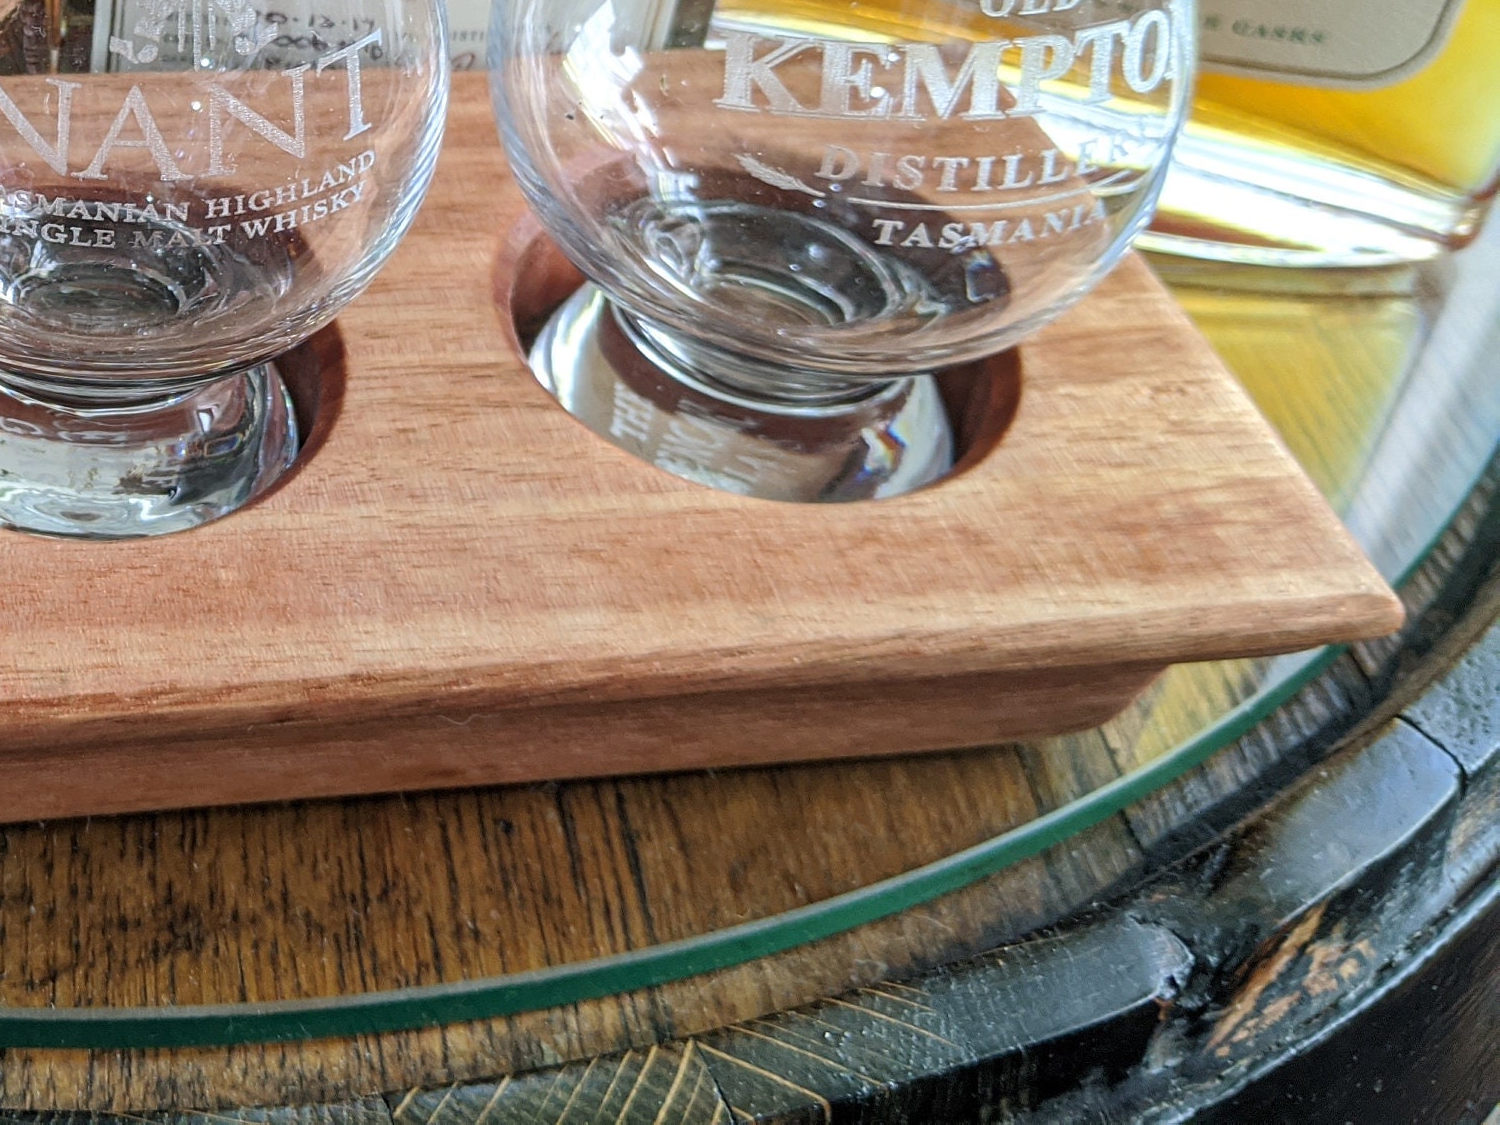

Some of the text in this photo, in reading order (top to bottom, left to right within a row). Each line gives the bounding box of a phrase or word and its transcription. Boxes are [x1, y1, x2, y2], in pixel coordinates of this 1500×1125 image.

[711, 8, 1175, 122] KEMPTO
[205, 149, 378, 220] HIGHLAND
[815, 127, 1140, 193] DISTILLER
[129, 223, 231, 248] MALT
[241, 180, 371, 239] WHISKY
[870, 195, 1108, 249] TASMANIA
